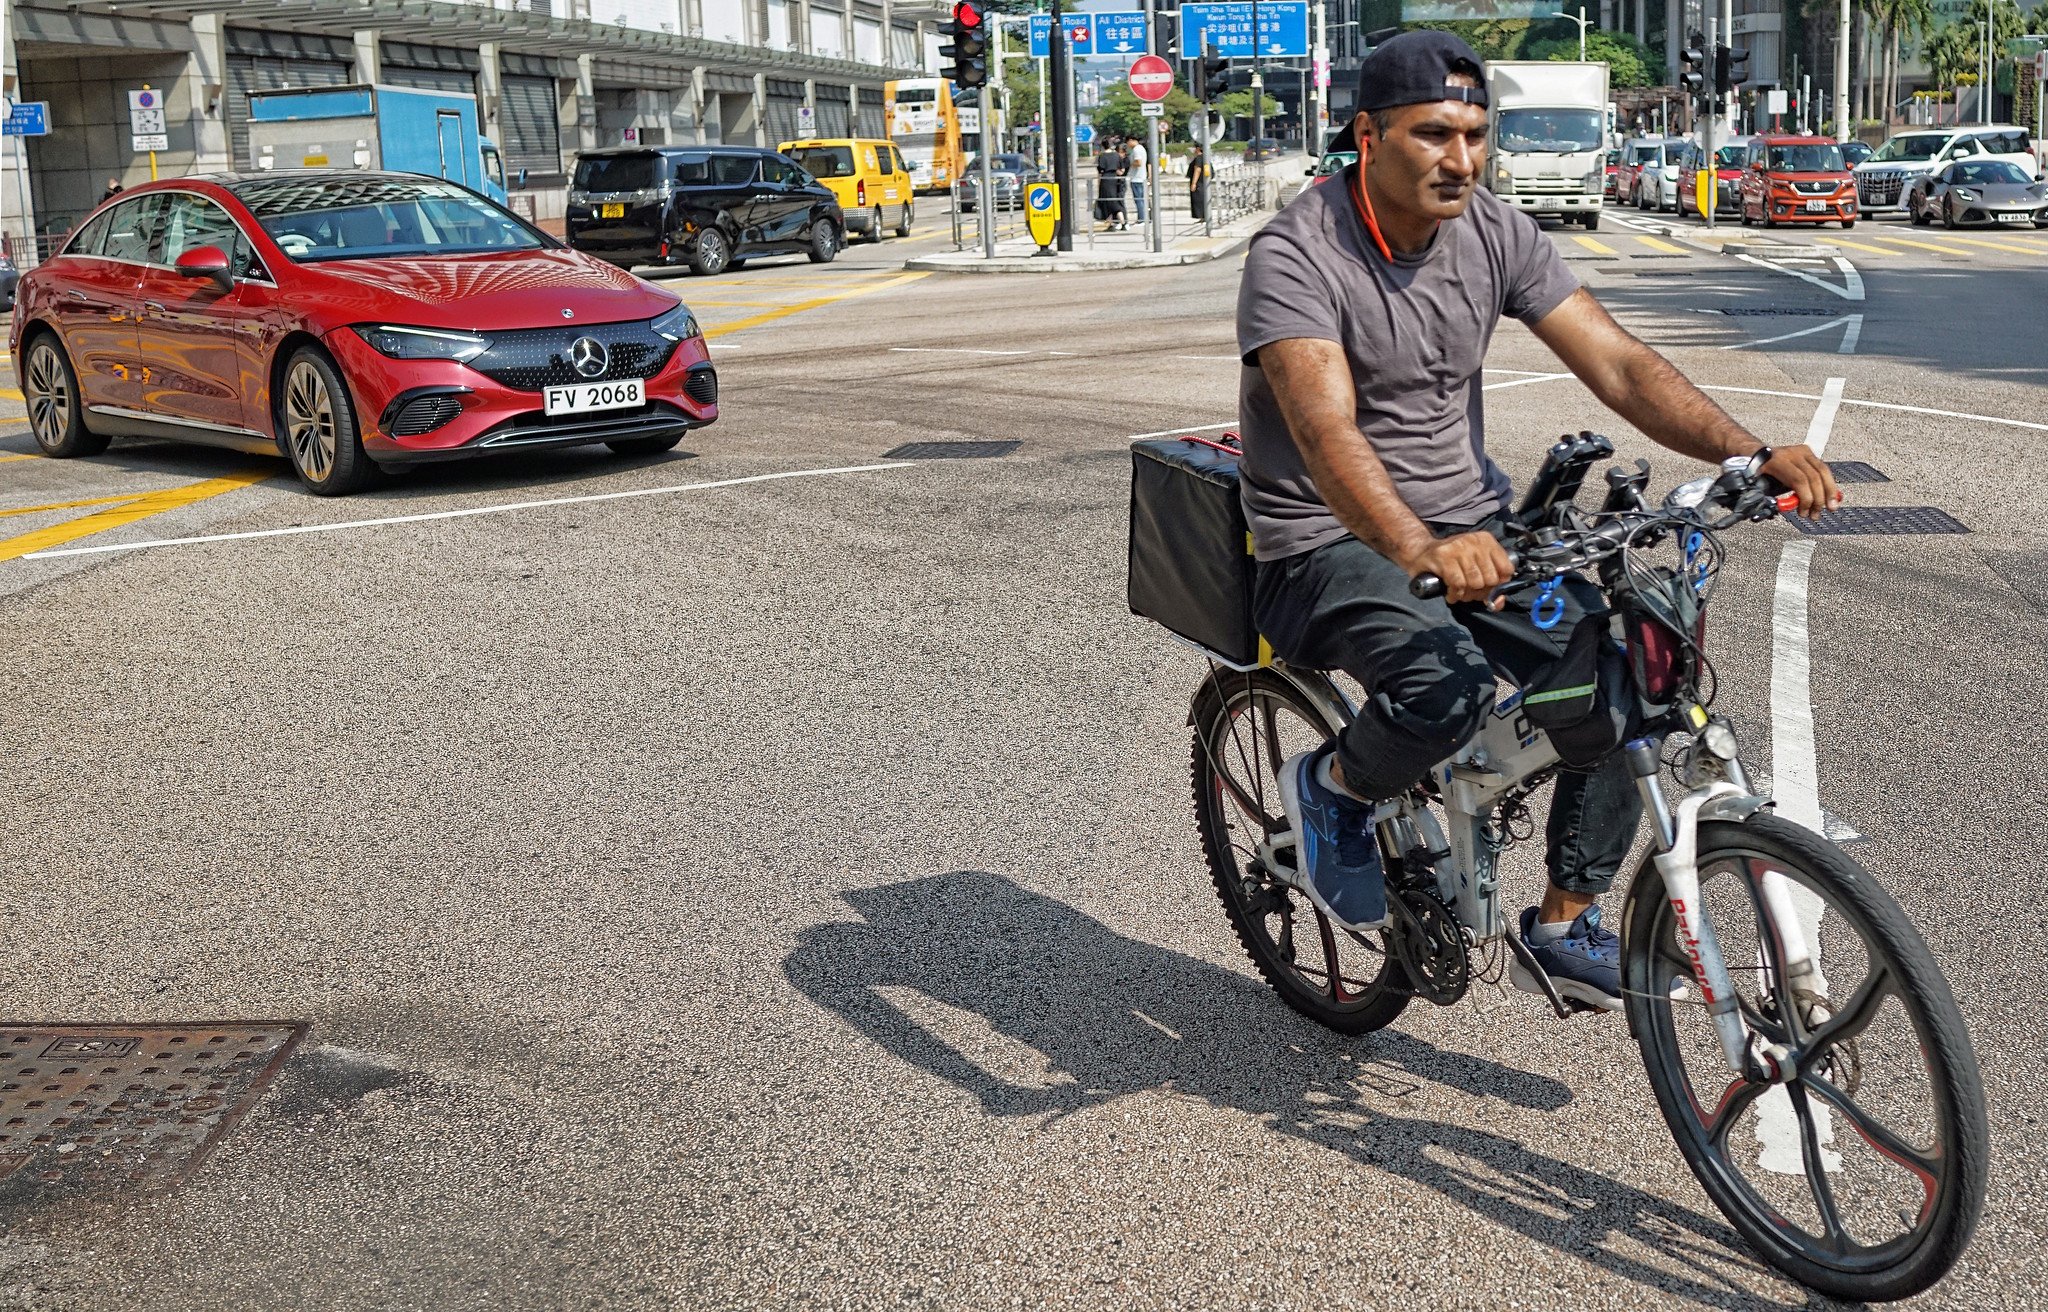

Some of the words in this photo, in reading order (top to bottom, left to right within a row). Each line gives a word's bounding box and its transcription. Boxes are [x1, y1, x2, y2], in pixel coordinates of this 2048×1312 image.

[1258, 5, 1276, 13] Hong
[1278, 4, 1297, 13] Kong
[1062, 17, 1087, 25] Road
[1098, 16, 1111, 24] All
[1227, 13, 1245, 21] Tong
[1105, 26, 1144, 40] 往各區
[549, 390, 576, 409] FV
[587, 384, 638, 407] 2068
[53, 1040, 132, 1052] E&M
